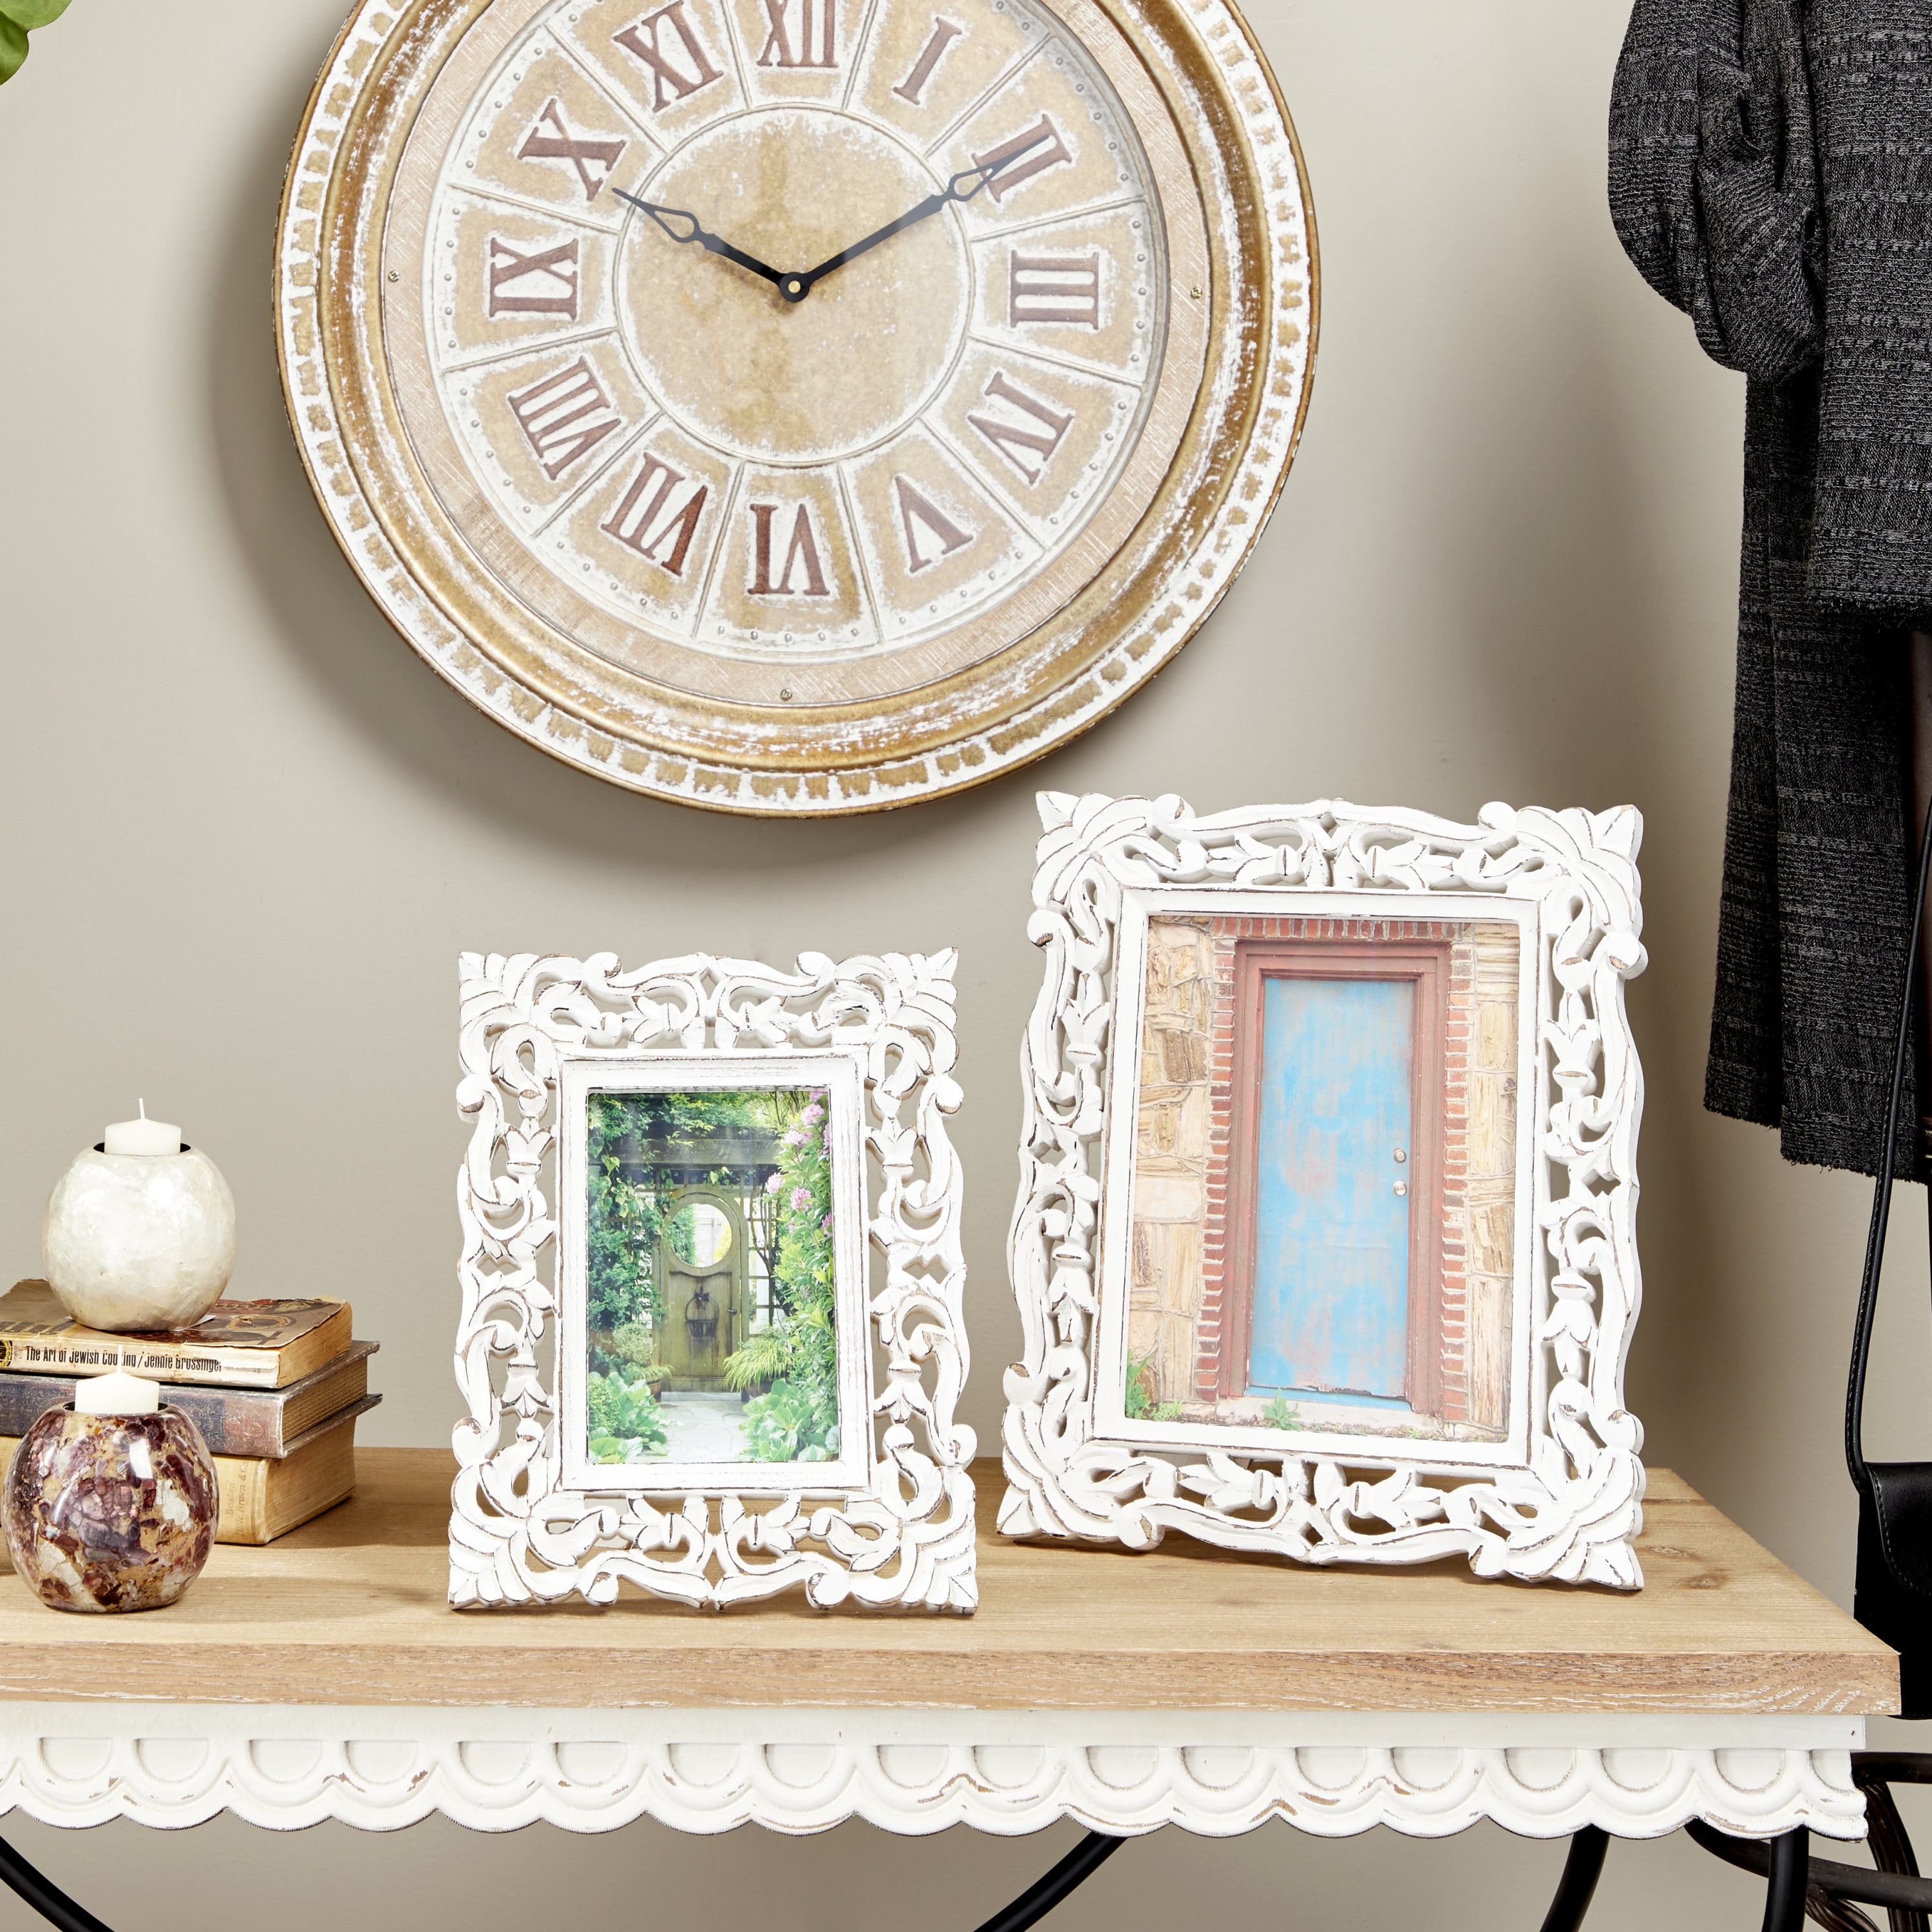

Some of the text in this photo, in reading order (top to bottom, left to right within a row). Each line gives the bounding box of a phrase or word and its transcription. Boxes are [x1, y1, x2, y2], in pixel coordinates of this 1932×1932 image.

[612, 0, 724, 112] XI
[756, 0, 840, 68] XII
[893, 16, 961, 105] I
[517, 98, 628, 201] X
[971, 113, 1072, 202] II
[489, 237, 578, 321] IX
[1010, 249, 1099, 330] III
[508, 355, 621, 480] VIII
[967, 371, 1075, 487] IV
[600, 452, 708, 576] VII
[747, 503, 829, 596] VI
[895, 475, 973, 573] V
[26, 1345, 41, 1361] The
[43, 1347, 56, 1362] Art
[59, 1348, 67, 1363] of
[69, 1349, 99, 1365] Jewish
[102, 1350, 136, 1367] Cooing
[144, 1352, 173, 1369] Jennie
[226, 1482, 236, 1515] Boston
